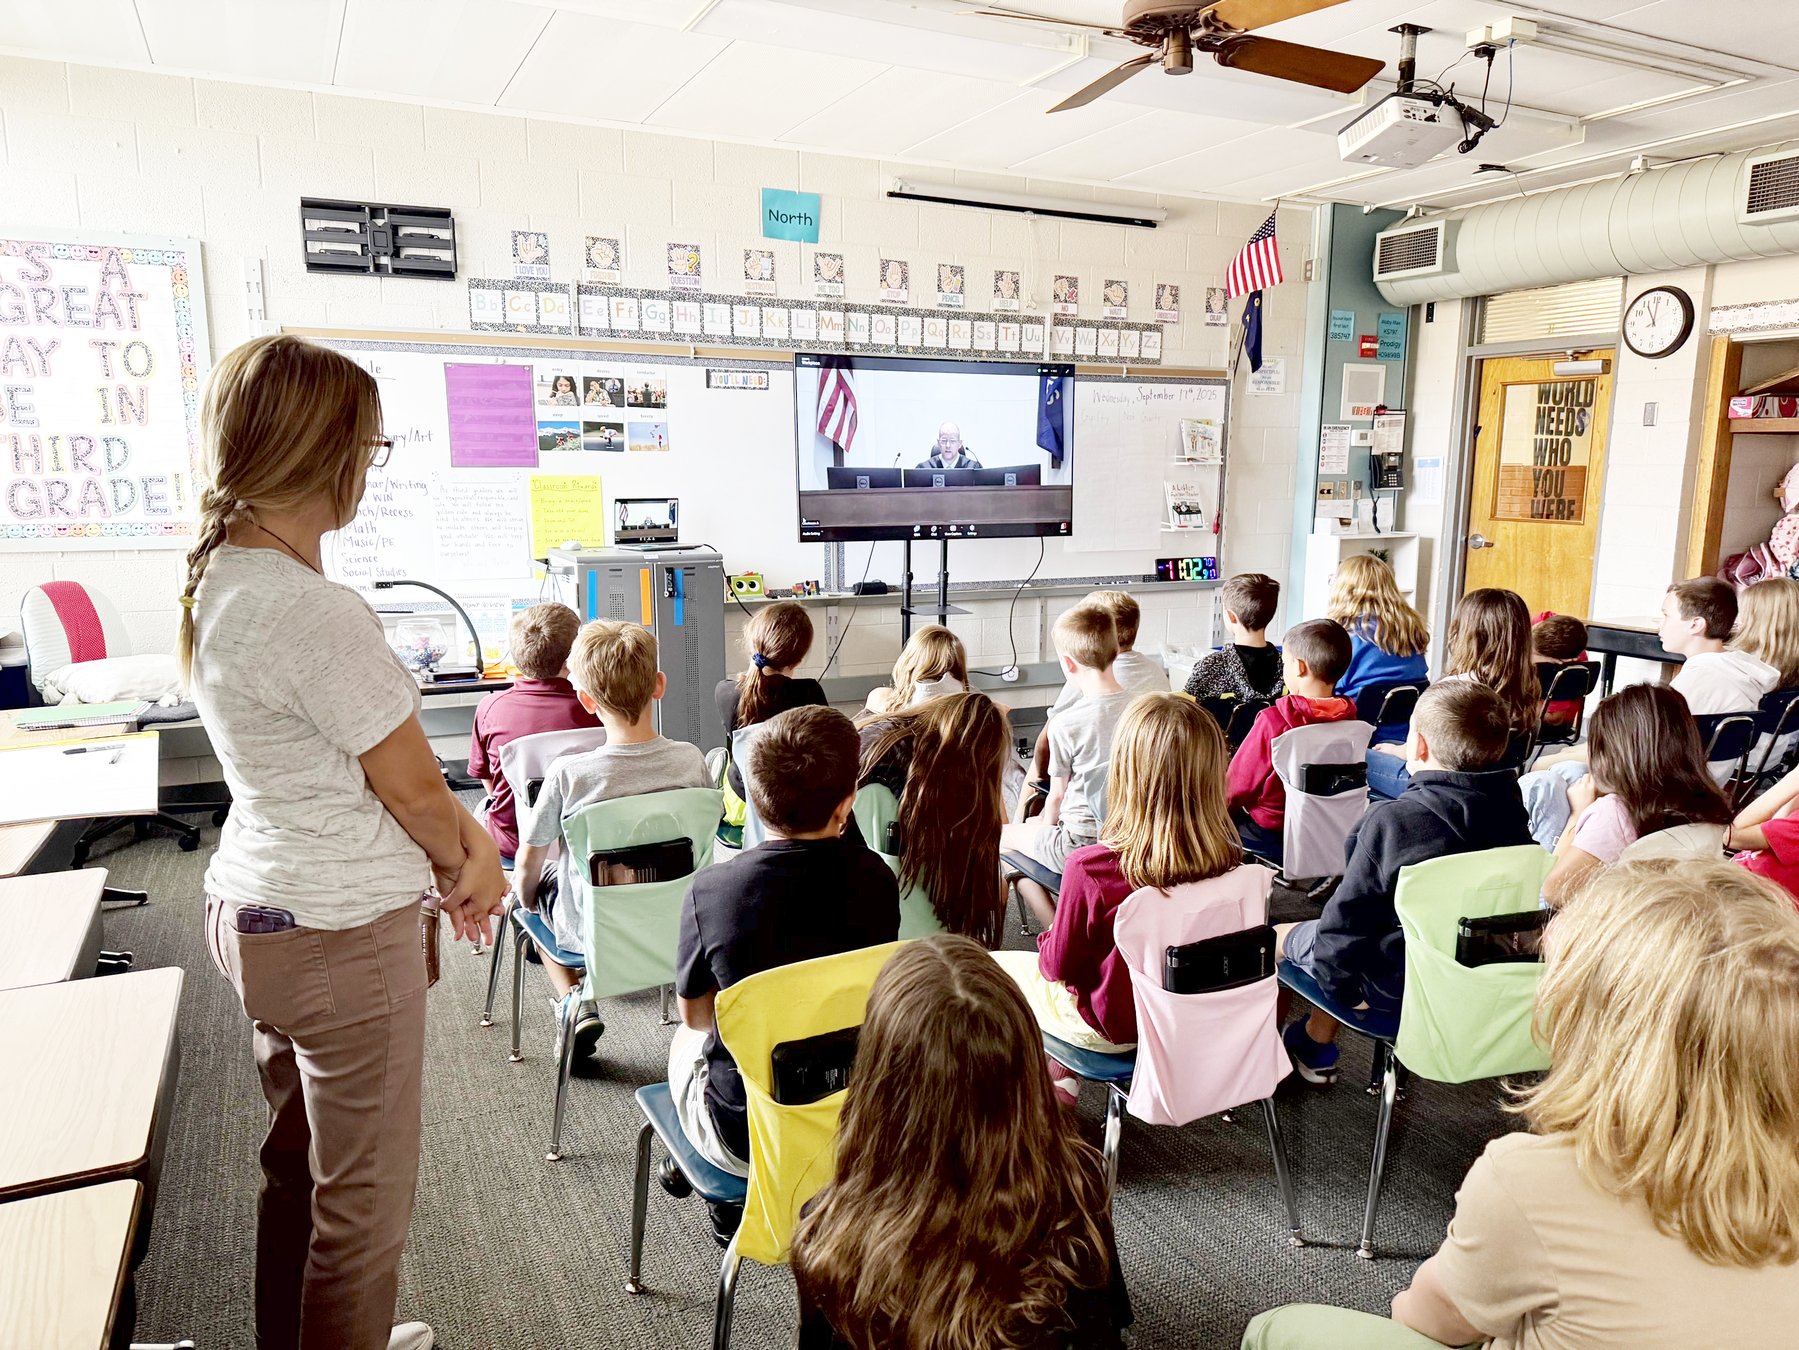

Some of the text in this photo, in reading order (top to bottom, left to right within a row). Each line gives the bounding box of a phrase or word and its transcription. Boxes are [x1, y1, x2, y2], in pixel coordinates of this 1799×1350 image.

[768, 208, 813, 227] North
[100, 249, 132, 289] A
[519, 265, 535, 275] LOVE
[536, 266, 548, 276] YOU
[670, 276, 700, 286] QUESTION
[0, 283, 148, 331] GREAT
[1379, 340, 1401, 349] Prodigy
[1, 334, 155, 379] AY TO
[713, 373, 766, 386] YOU'LL NEED:
[1136, 385, 1175, 406] September
[1537, 381, 1595, 408] WORLD
[97, 385, 149, 427] IN
[1534, 406, 1587, 437] NEEDS
[0, 432, 132, 475] HIRD
[1533, 438, 1572, 467] WHO
[1532, 468, 1566, 498] YOU
[372, 492, 394, 502] WIN
[344, 520, 377, 534] Math
[341, 552, 378, 564] Science
[342, 566, 407, 578] Social Studies
